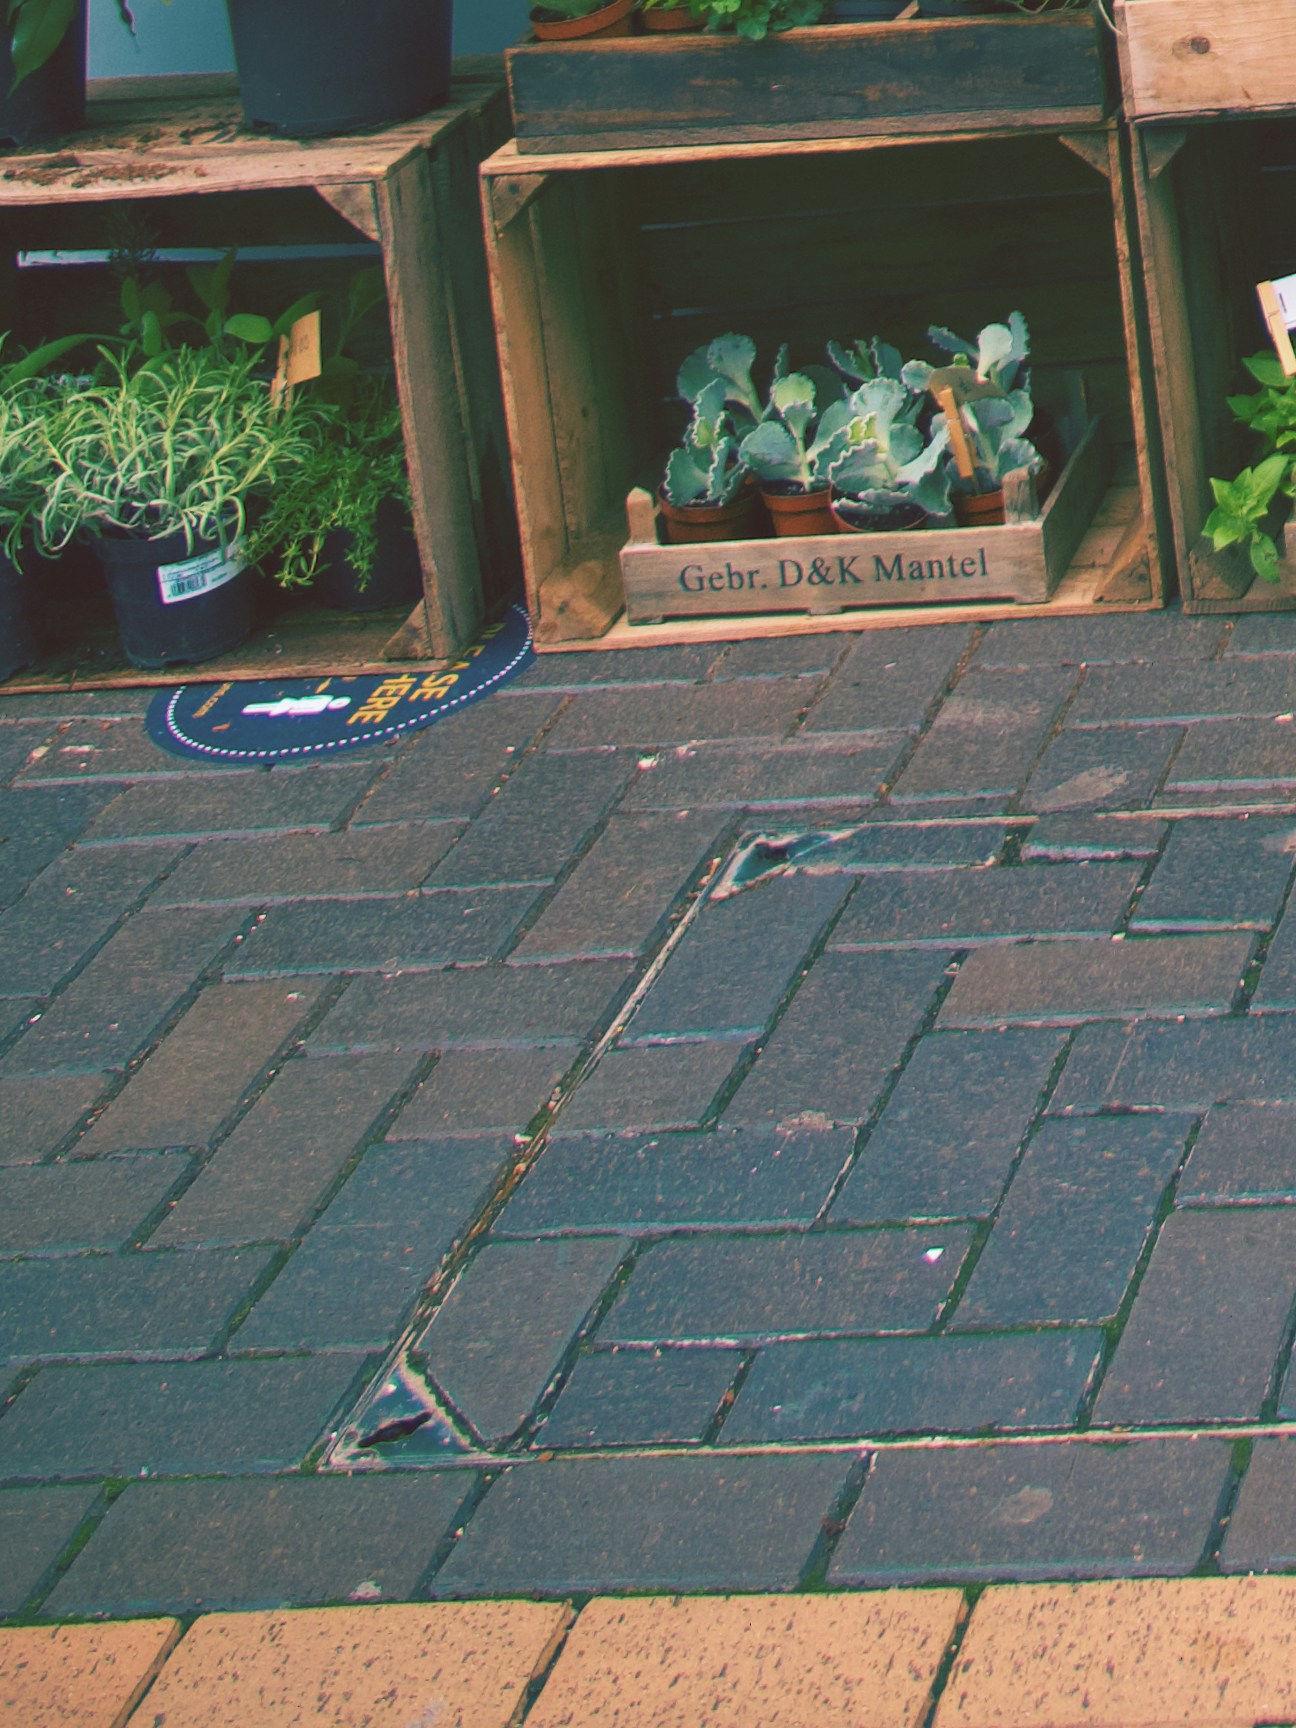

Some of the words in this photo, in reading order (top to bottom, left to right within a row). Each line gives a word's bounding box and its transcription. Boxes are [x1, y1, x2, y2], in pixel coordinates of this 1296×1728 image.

[679, 562, 768, 593] Gebr.
[779, 555, 862, 588] D&K
[874, 548, 988, 581] Mantel
